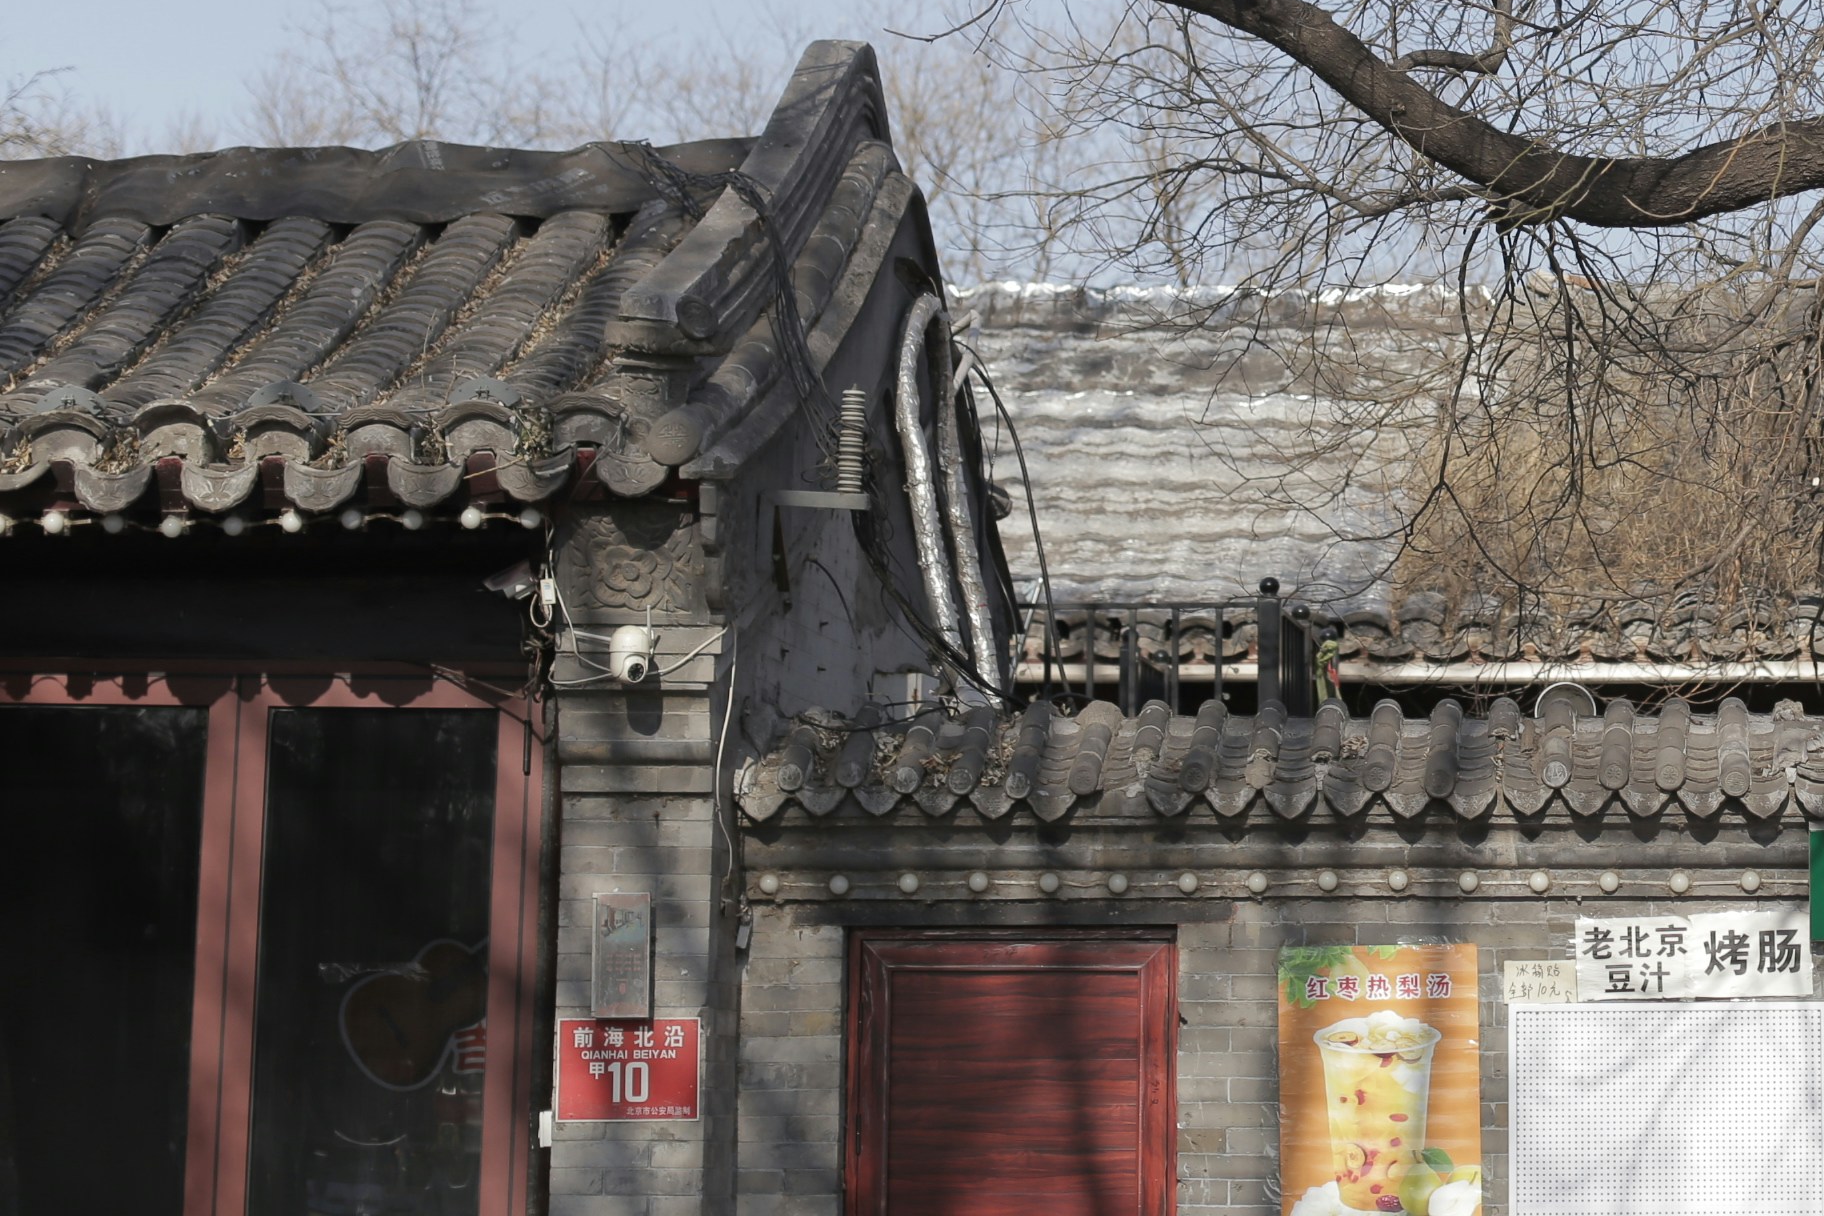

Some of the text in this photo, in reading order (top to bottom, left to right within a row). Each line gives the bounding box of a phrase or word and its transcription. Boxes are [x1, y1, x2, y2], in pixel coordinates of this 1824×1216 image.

[1582, 924, 1688, 960] 老北京
[1703, 929, 1801, 976] 烤肠
[1306, 973, 1451, 1000] 红枣热梨汤
[1605, 961, 1671, 993] 豆汁
[573, 1026, 684, 1048] 前海北沿
[581, 1049, 676, 1060] QIANHAI BEIYAN
